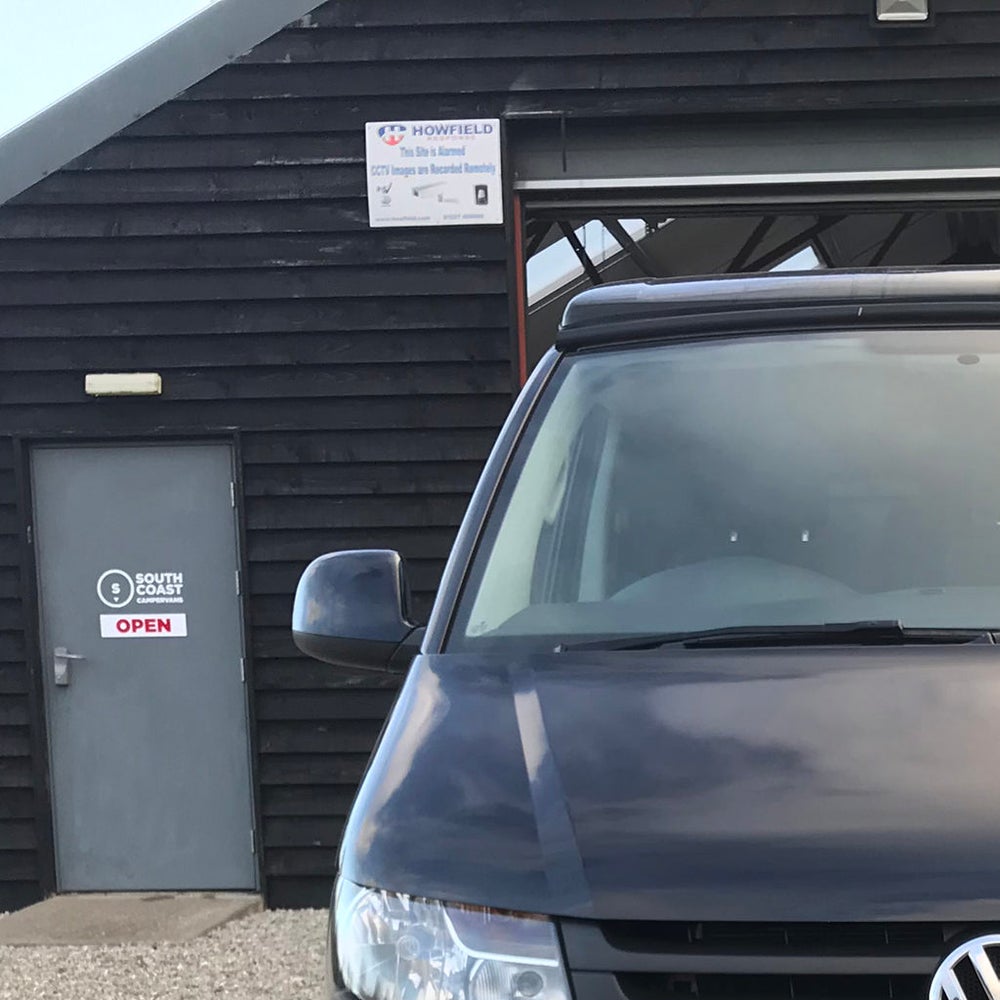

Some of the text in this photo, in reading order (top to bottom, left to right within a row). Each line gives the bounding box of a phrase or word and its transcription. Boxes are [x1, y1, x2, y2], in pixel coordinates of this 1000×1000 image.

[412, 123, 493, 136] HOWFIELD
[416, 146, 429, 157] Site
[371, 164, 390, 176] CCTV
[391, 164, 416, 176] Images
[135, 572, 183, 584] SOUTH
[111, 583, 121, 594] S
[136, 584, 184, 595] COAST
[116, 618, 172, 633] OPEN
